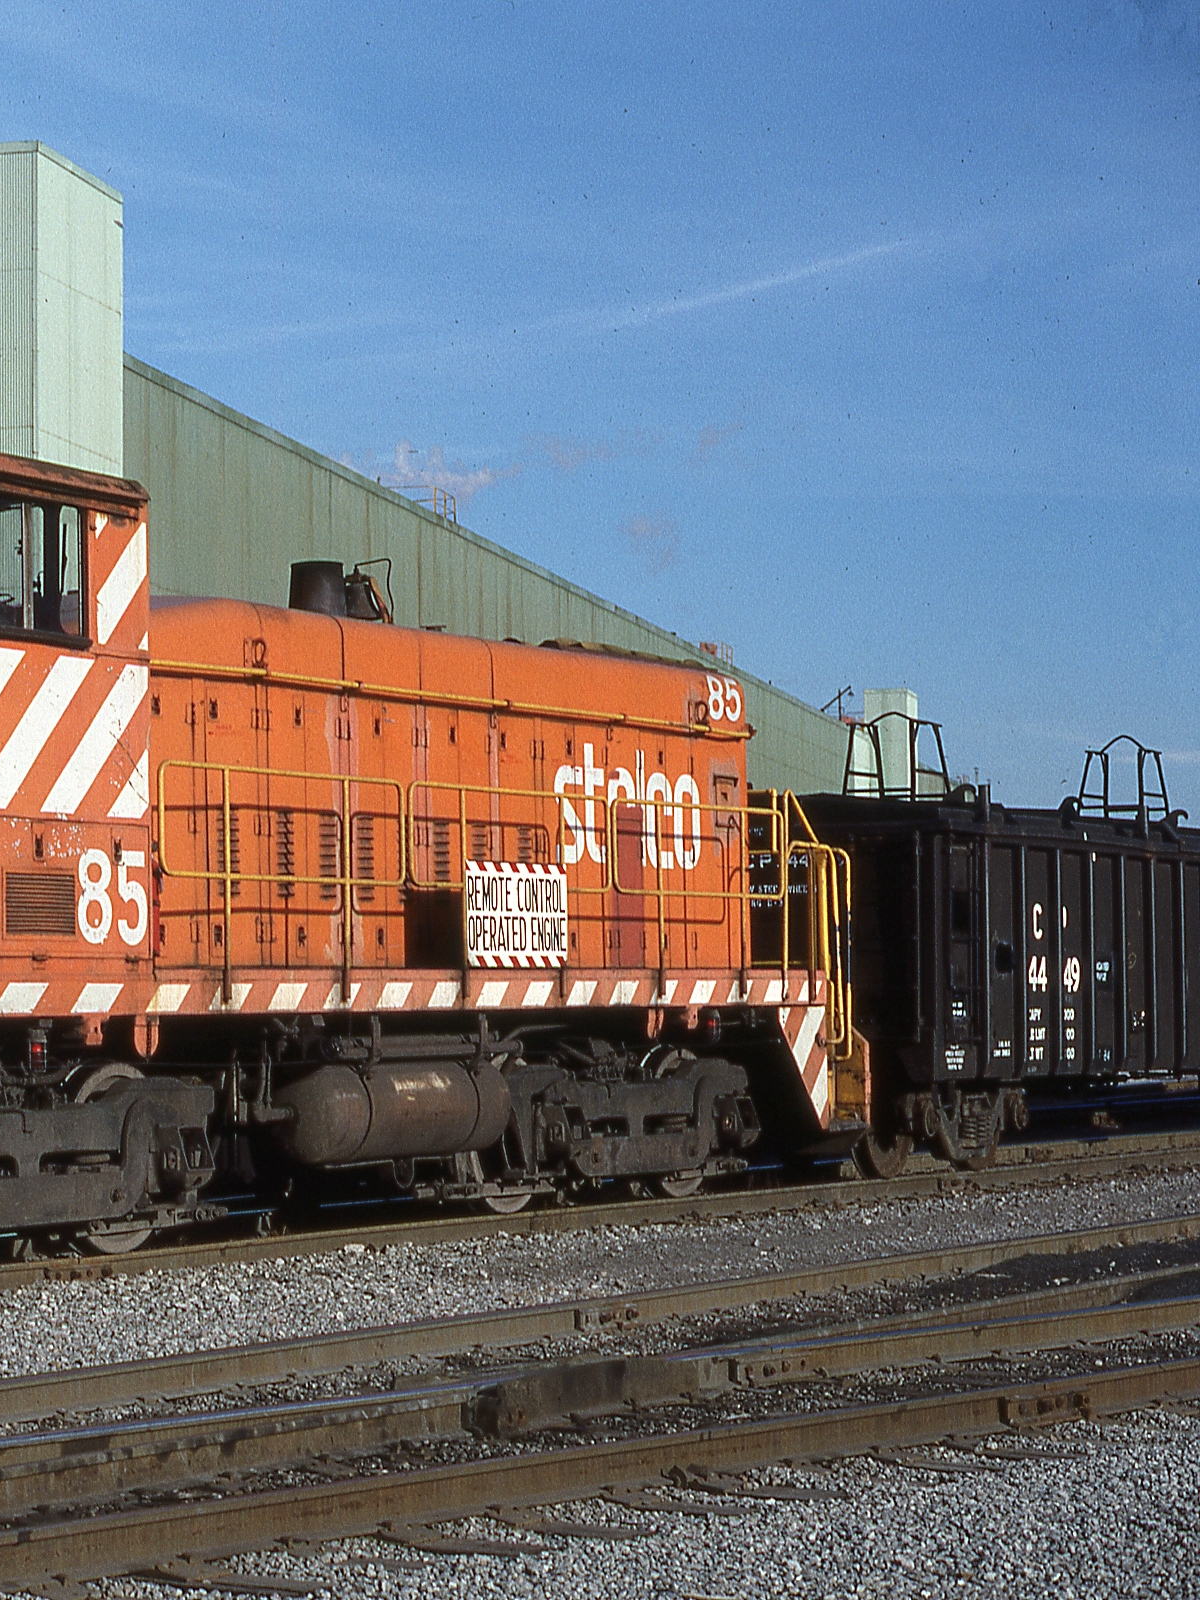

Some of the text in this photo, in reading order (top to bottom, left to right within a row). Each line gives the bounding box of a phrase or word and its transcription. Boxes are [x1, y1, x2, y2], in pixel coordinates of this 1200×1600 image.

[706, 675, 741, 722] 85
[78, 848, 148, 946] 85
[467, 875, 566, 913] REMOTE CONTROL
[468, 915, 567, 952] OPERATED ENGINE
